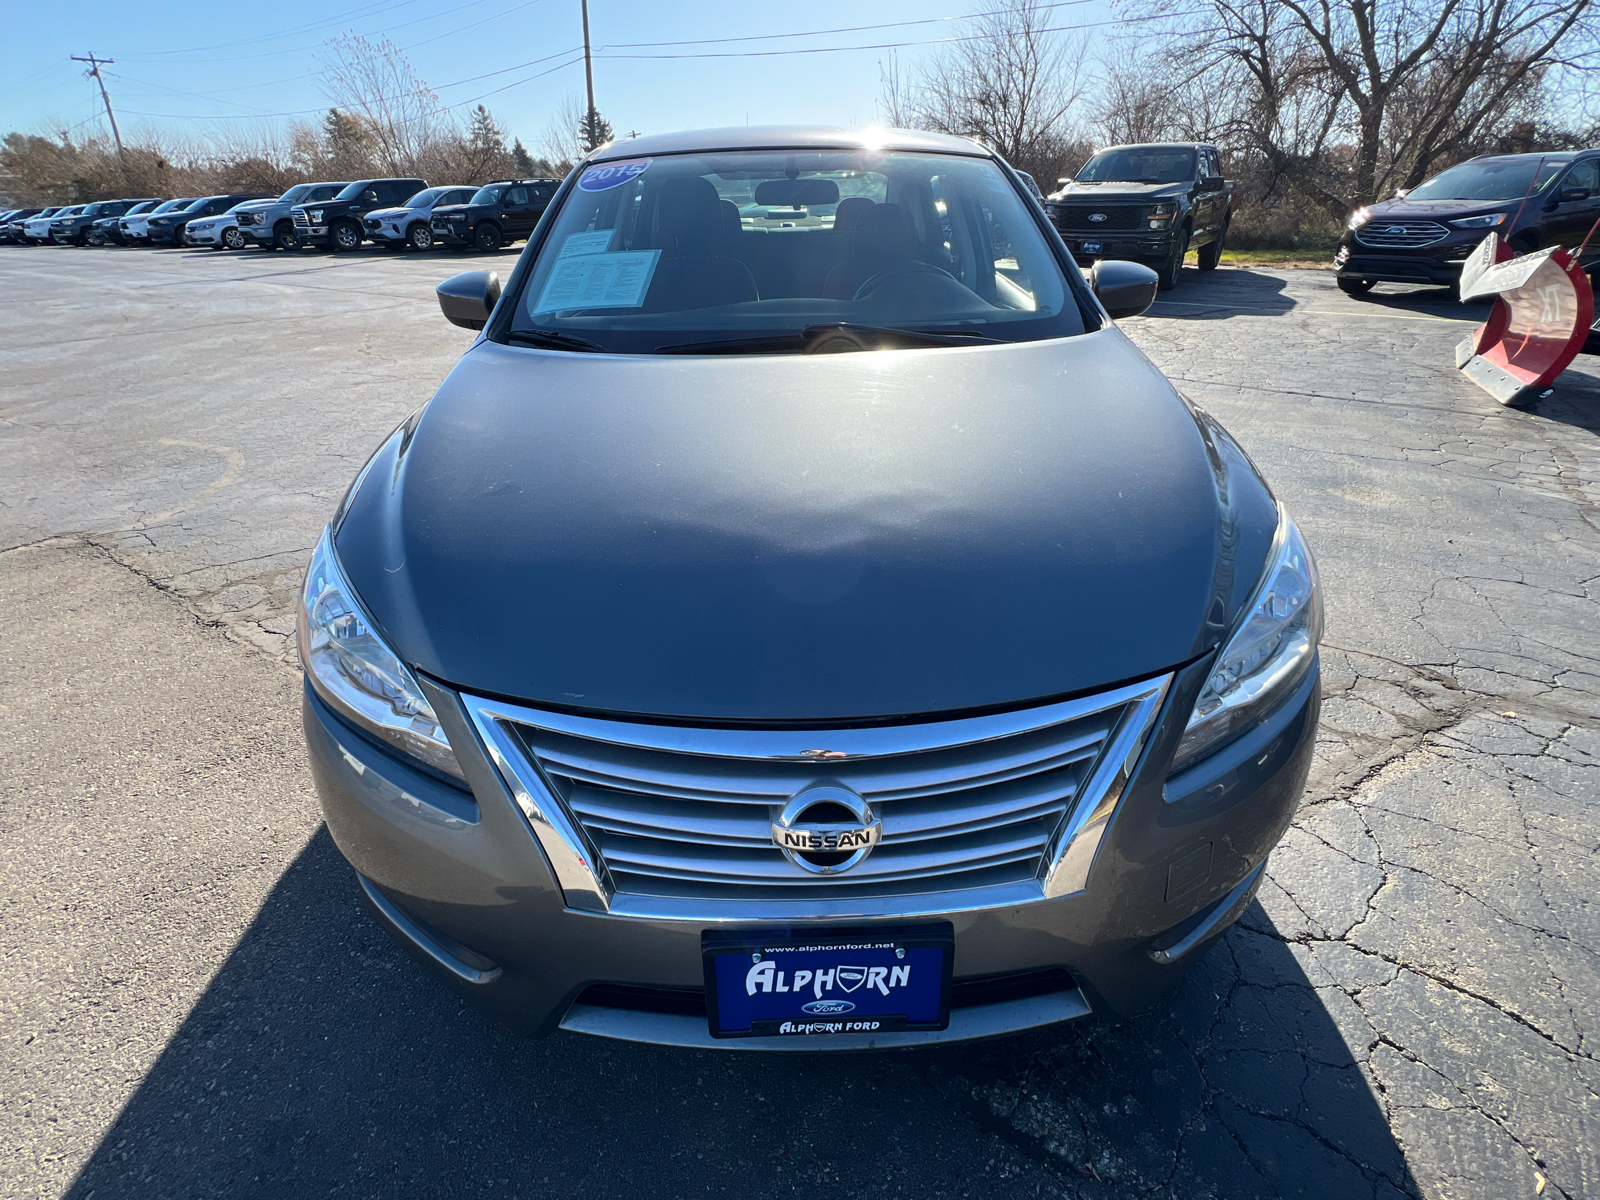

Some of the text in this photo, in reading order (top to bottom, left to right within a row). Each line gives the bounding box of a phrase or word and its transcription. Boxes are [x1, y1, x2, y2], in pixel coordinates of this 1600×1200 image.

[582, 163, 645, 184] 2015
[784, 831, 870, 848] NISSAN
[764, 943, 895, 953] www.alphornford.net
[813, 1002, 845, 1013] Ford
[845, 1022, 880, 1031] FORD
